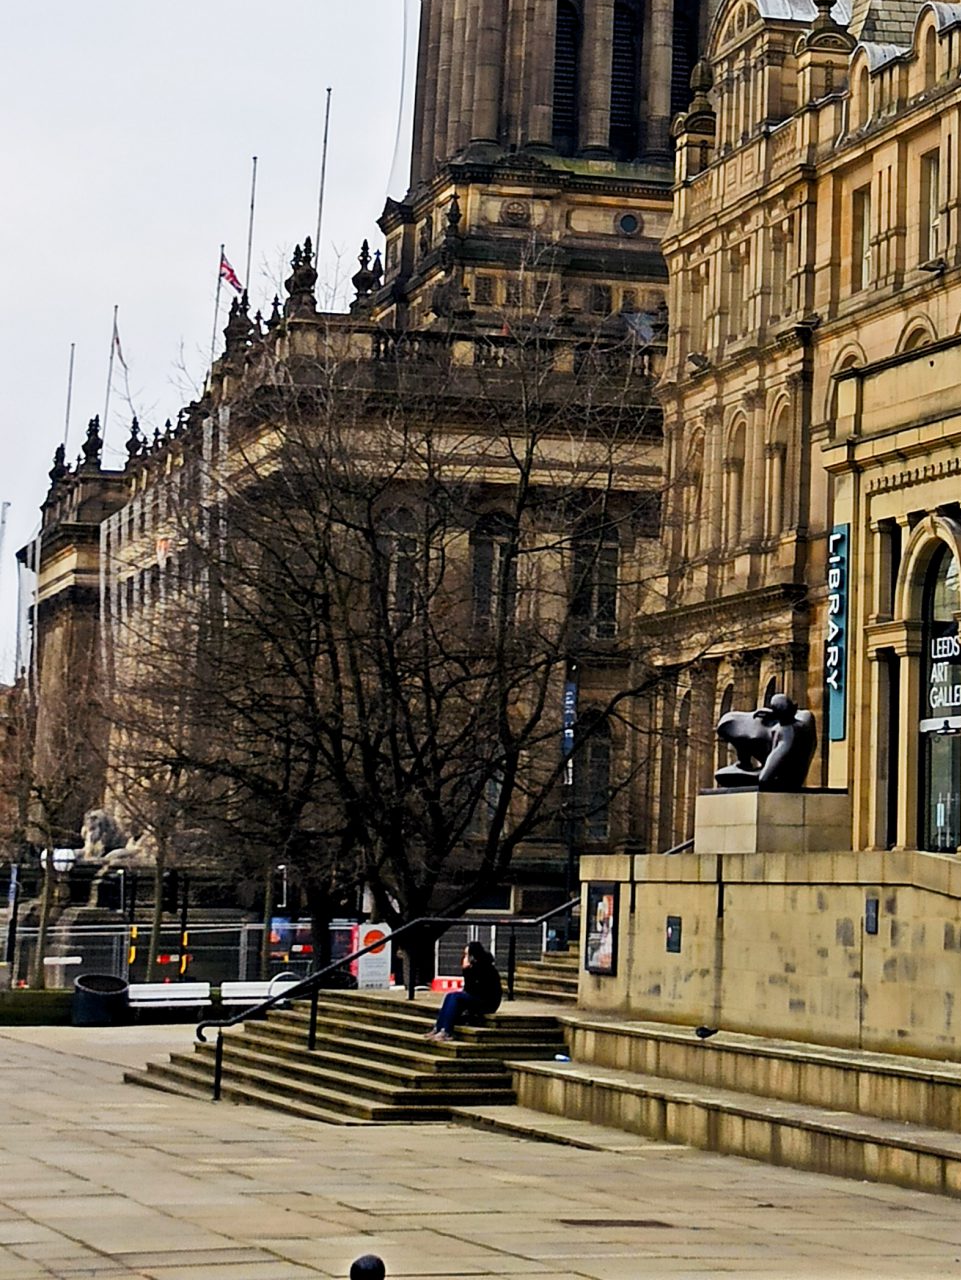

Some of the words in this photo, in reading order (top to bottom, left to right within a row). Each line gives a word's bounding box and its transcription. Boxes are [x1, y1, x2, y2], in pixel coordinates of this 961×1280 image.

[826, 533, 841, 690] LIBRARY
[931, 634, 960, 658] LEEDS
[930, 661, 949, 683] ART
